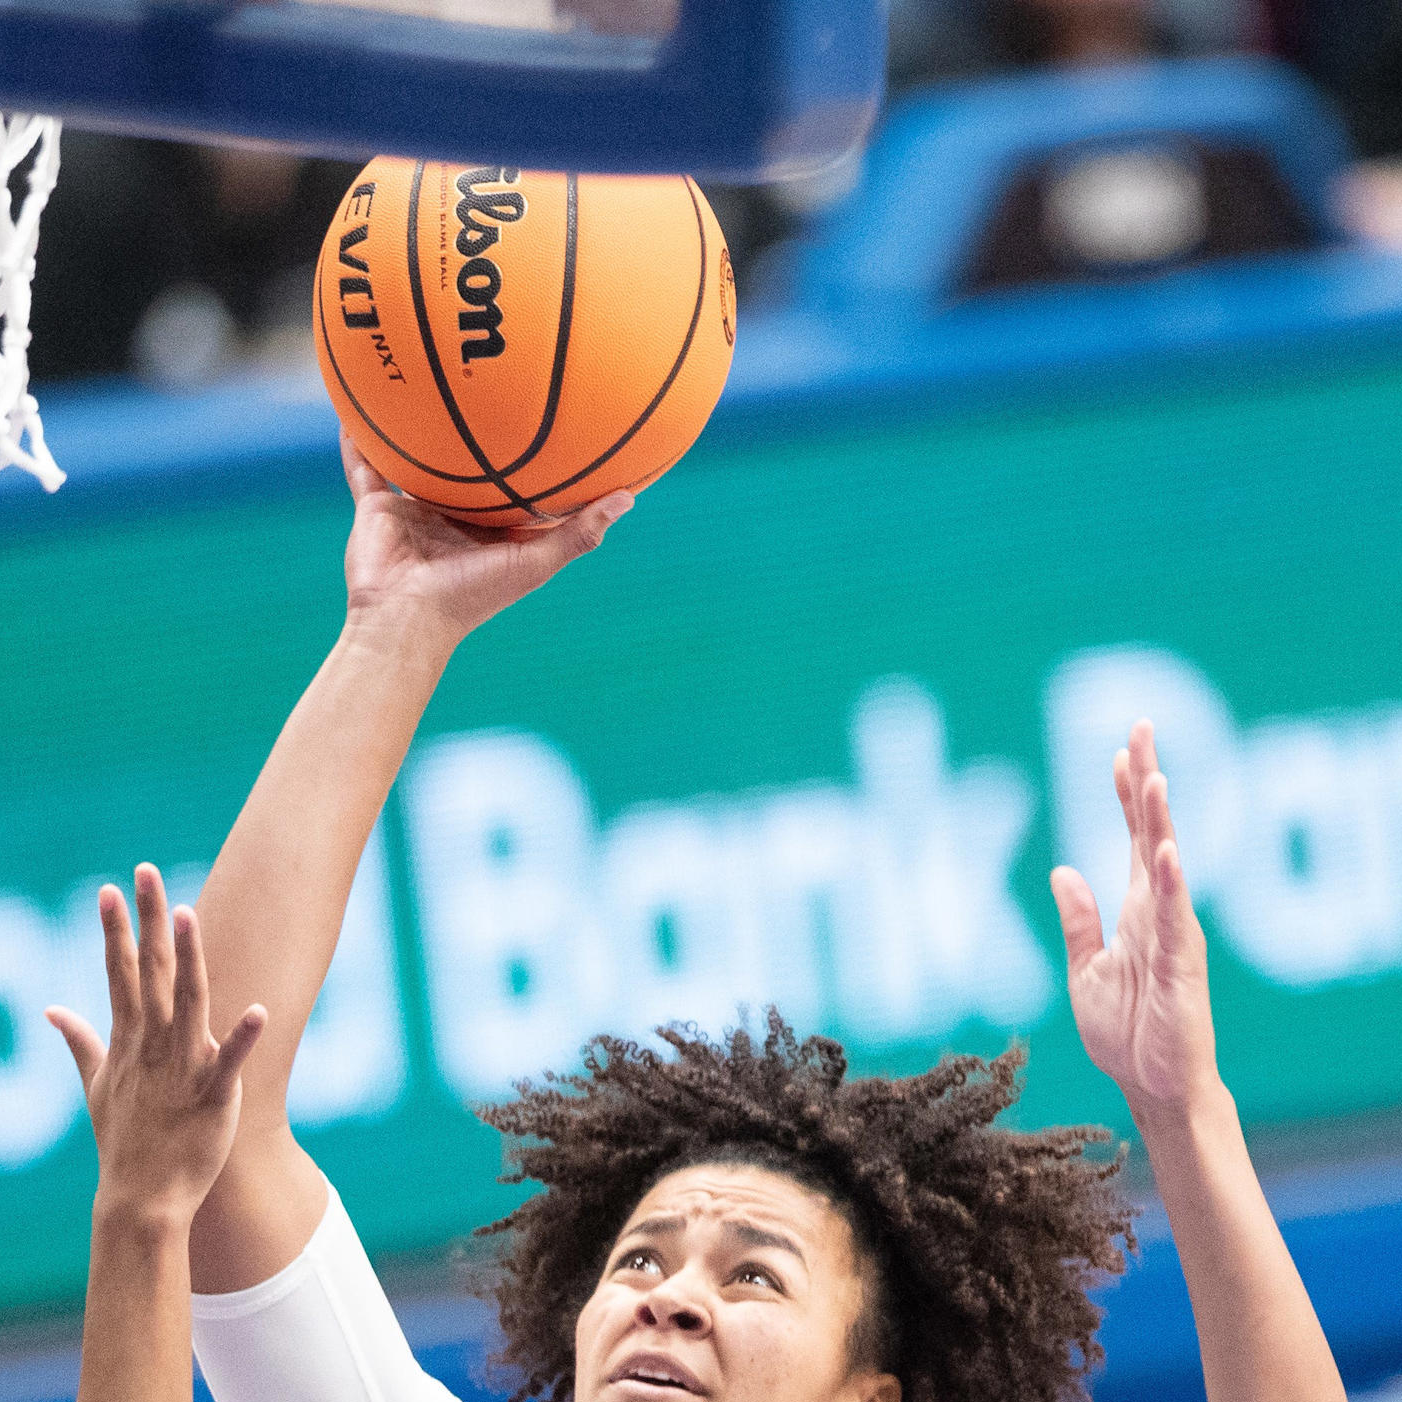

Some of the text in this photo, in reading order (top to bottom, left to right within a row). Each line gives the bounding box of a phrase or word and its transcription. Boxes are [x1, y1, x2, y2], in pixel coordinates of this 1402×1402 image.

[338, 182, 407, 384] EVO NXT
[439, 214, 448, 250] GAME
[439, 256, 449, 291] BALL
[455, 166, 529, 365] ilson
[408, 674, 1058, 1100] Bank
